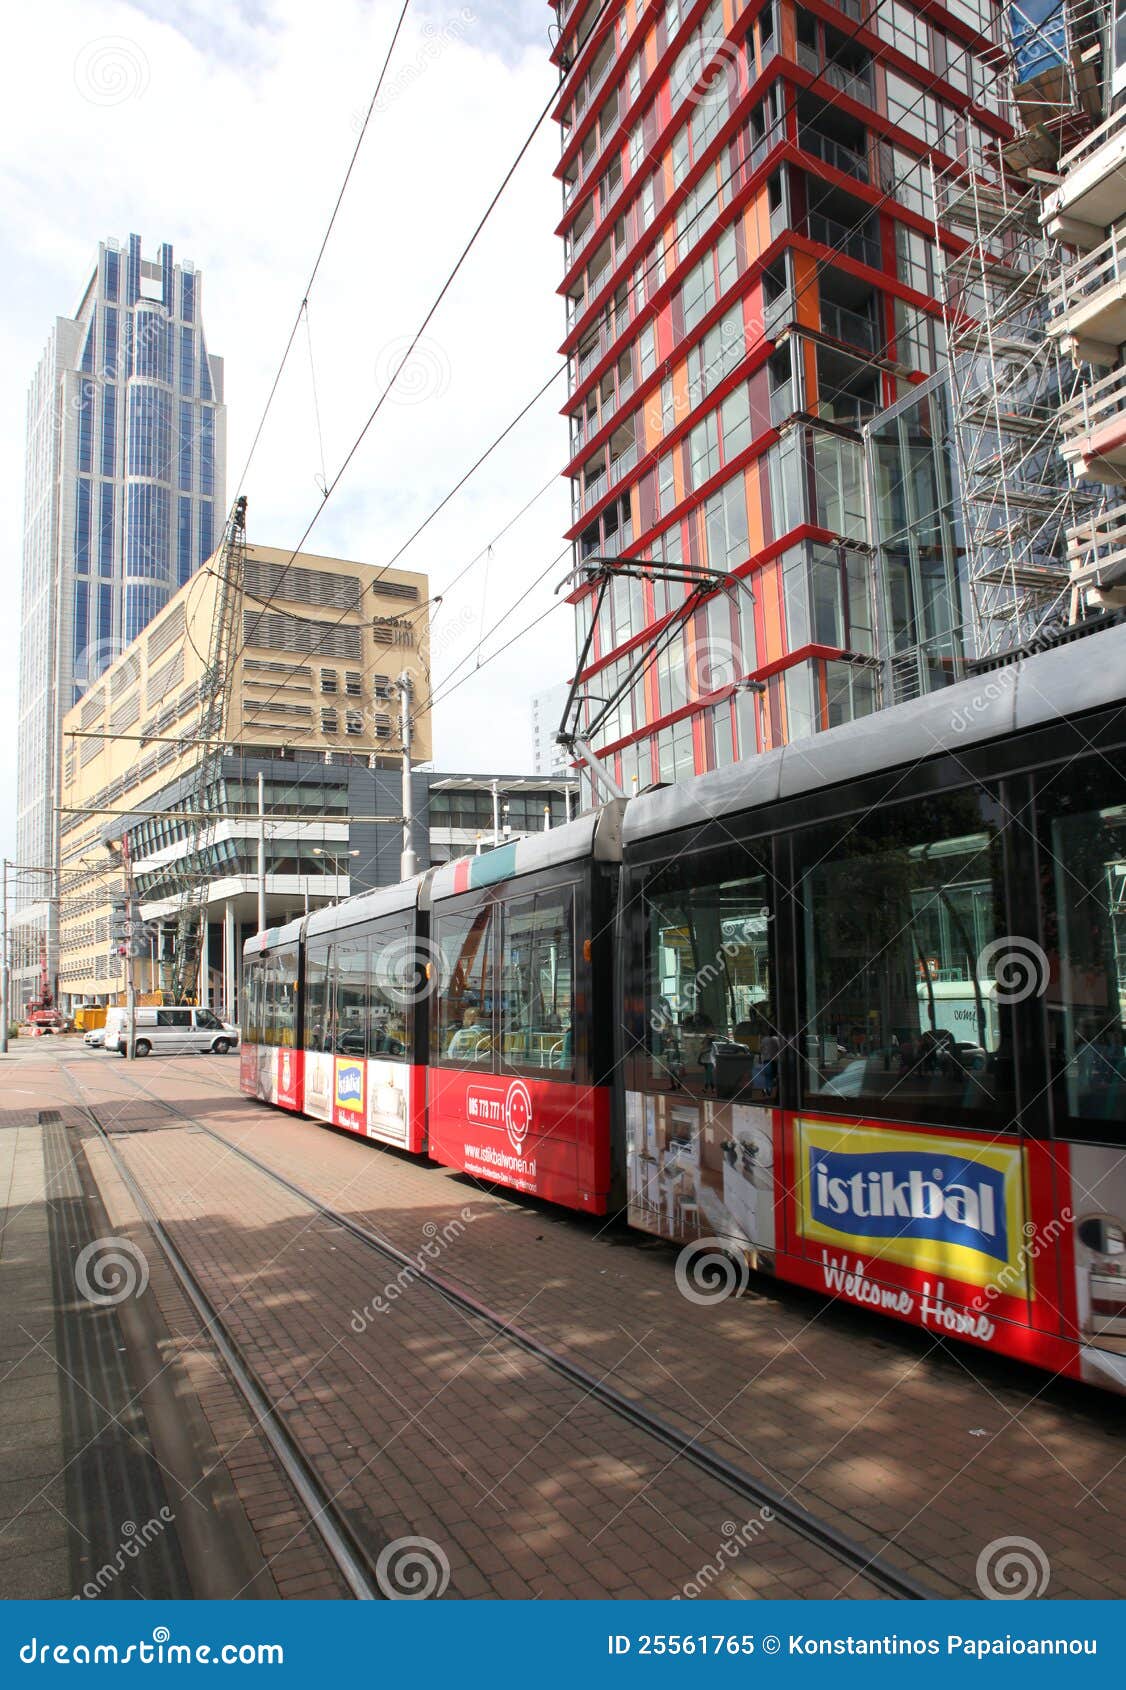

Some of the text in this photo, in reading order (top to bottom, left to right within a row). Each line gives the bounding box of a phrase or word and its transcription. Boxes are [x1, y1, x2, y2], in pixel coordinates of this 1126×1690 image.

[489, 1101, 500, 1121] 777
[464, 1143, 537, 1177] www.istikbalwonen.nl
[816, 1162, 996, 1237] istikbal
[821, 1248, 996, 1342] Welcome Home
